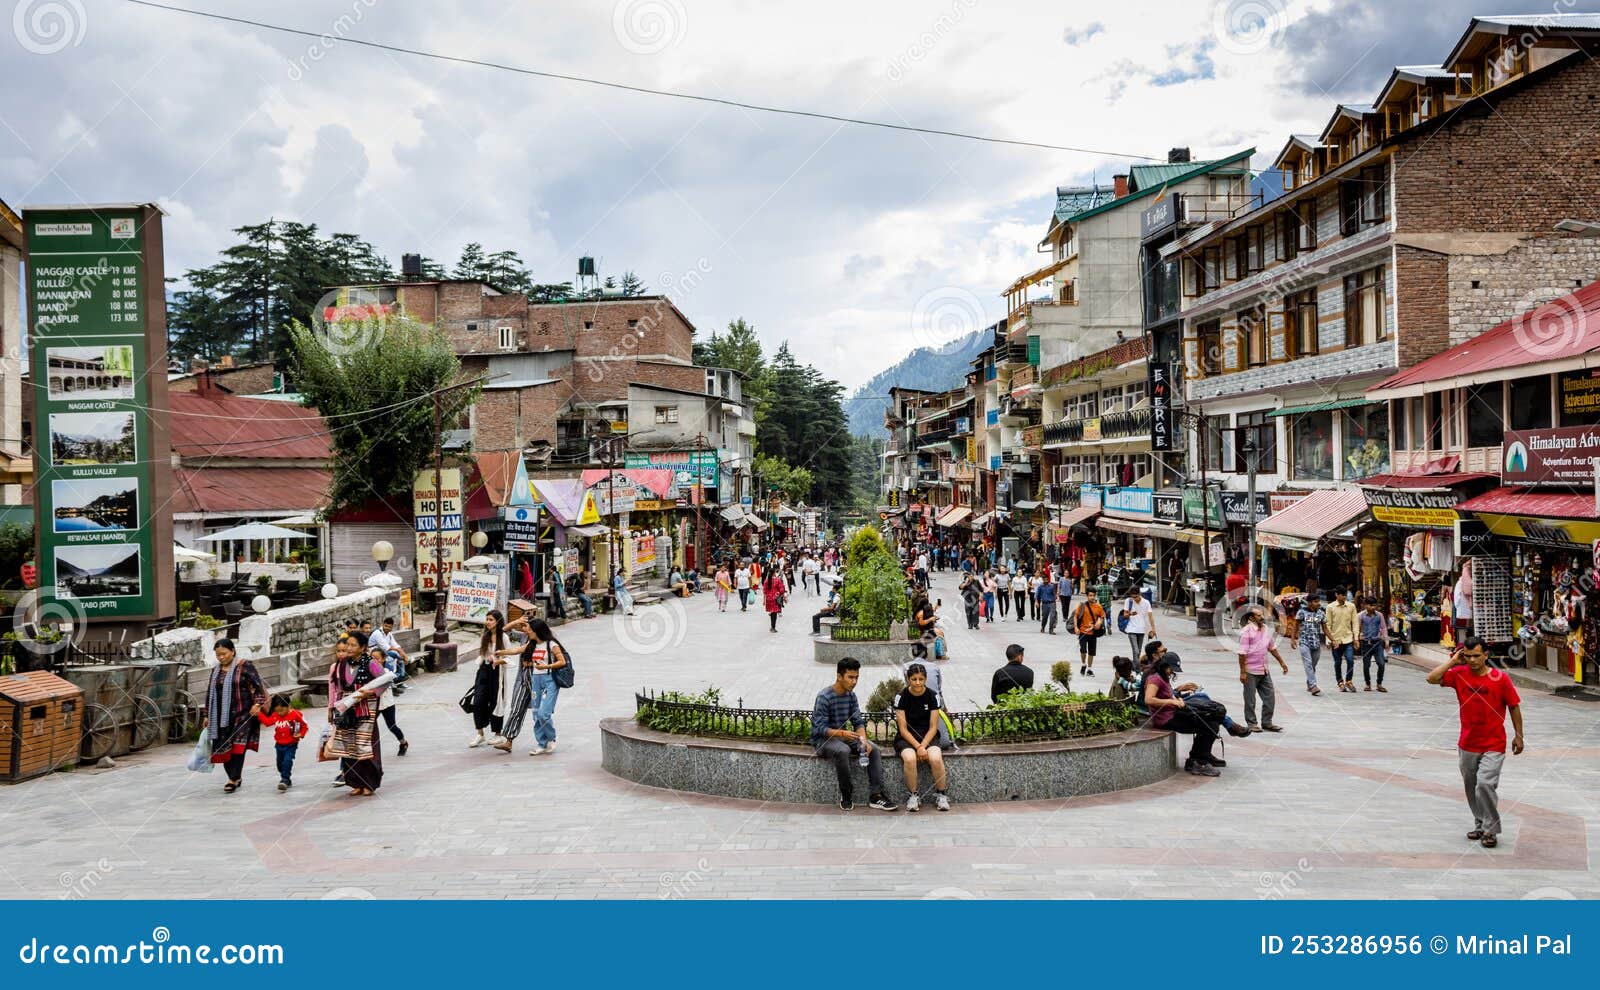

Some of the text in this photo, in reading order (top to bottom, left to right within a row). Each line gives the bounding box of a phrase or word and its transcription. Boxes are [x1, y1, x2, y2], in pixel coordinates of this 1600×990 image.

[36, 268, 74, 276] NAGGAR
[76, 266, 108, 276] CASTLE
[36, 280, 64, 288] KULLU
[37, 291, 92, 300] MANIKARAN
[38, 304, 68, 312] MANDI
[124, 302, 137, 310] KMS
[38, 315, 79, 324] BILASPUR
[1529, 434, 1576, 452] Himalayan
[1542, 458, 1572, 466] Adventure
[1572, 456, 1586, 465] Tour
[1224, 497, 1265, 512] Kashir
[1364, 490, 1458, 509] Shiva Gift Corner
[421, 500, 456, 512] HOEL
[452, 580, 496, 590] HIMACHAL TOURISM
[452, 587, 494, 598] WELCOME
[472, 597, 492, 606] SPECIAL
